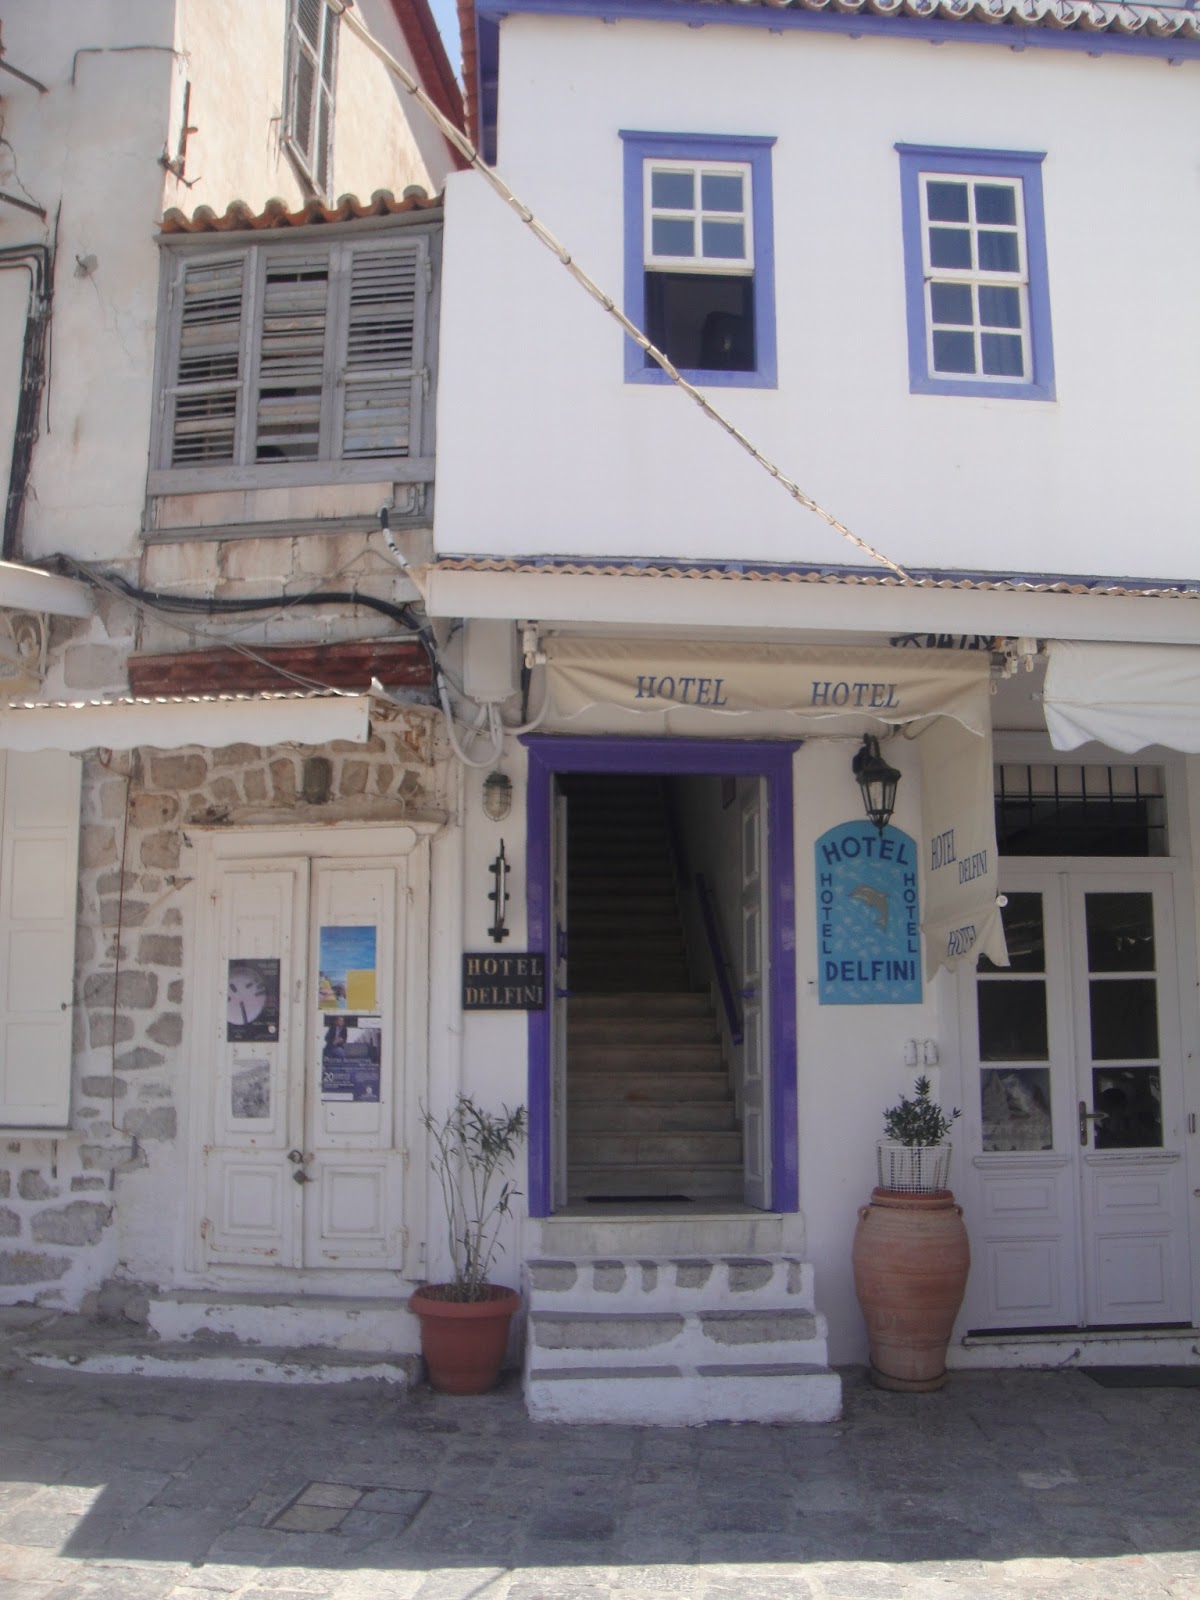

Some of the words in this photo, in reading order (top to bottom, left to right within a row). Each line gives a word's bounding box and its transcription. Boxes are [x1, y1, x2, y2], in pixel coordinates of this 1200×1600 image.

[635, 676, 728, 705] HOTEL
[808, 681, 900, 708] HOTEL
[821, 836, 909, 866] HOTEL
[931, 829, 956, 871] HOTEL
[958, 849, 988, 885] DELFINI
[820, 872, 834, 955] HOTEL
[903, 872, 918, 954] HOTEL
[466, 957, 544, 976] HOTEL
[825, 960, 916, 982] DELFINI
[464, 985, 545, 1005] DELFINI
